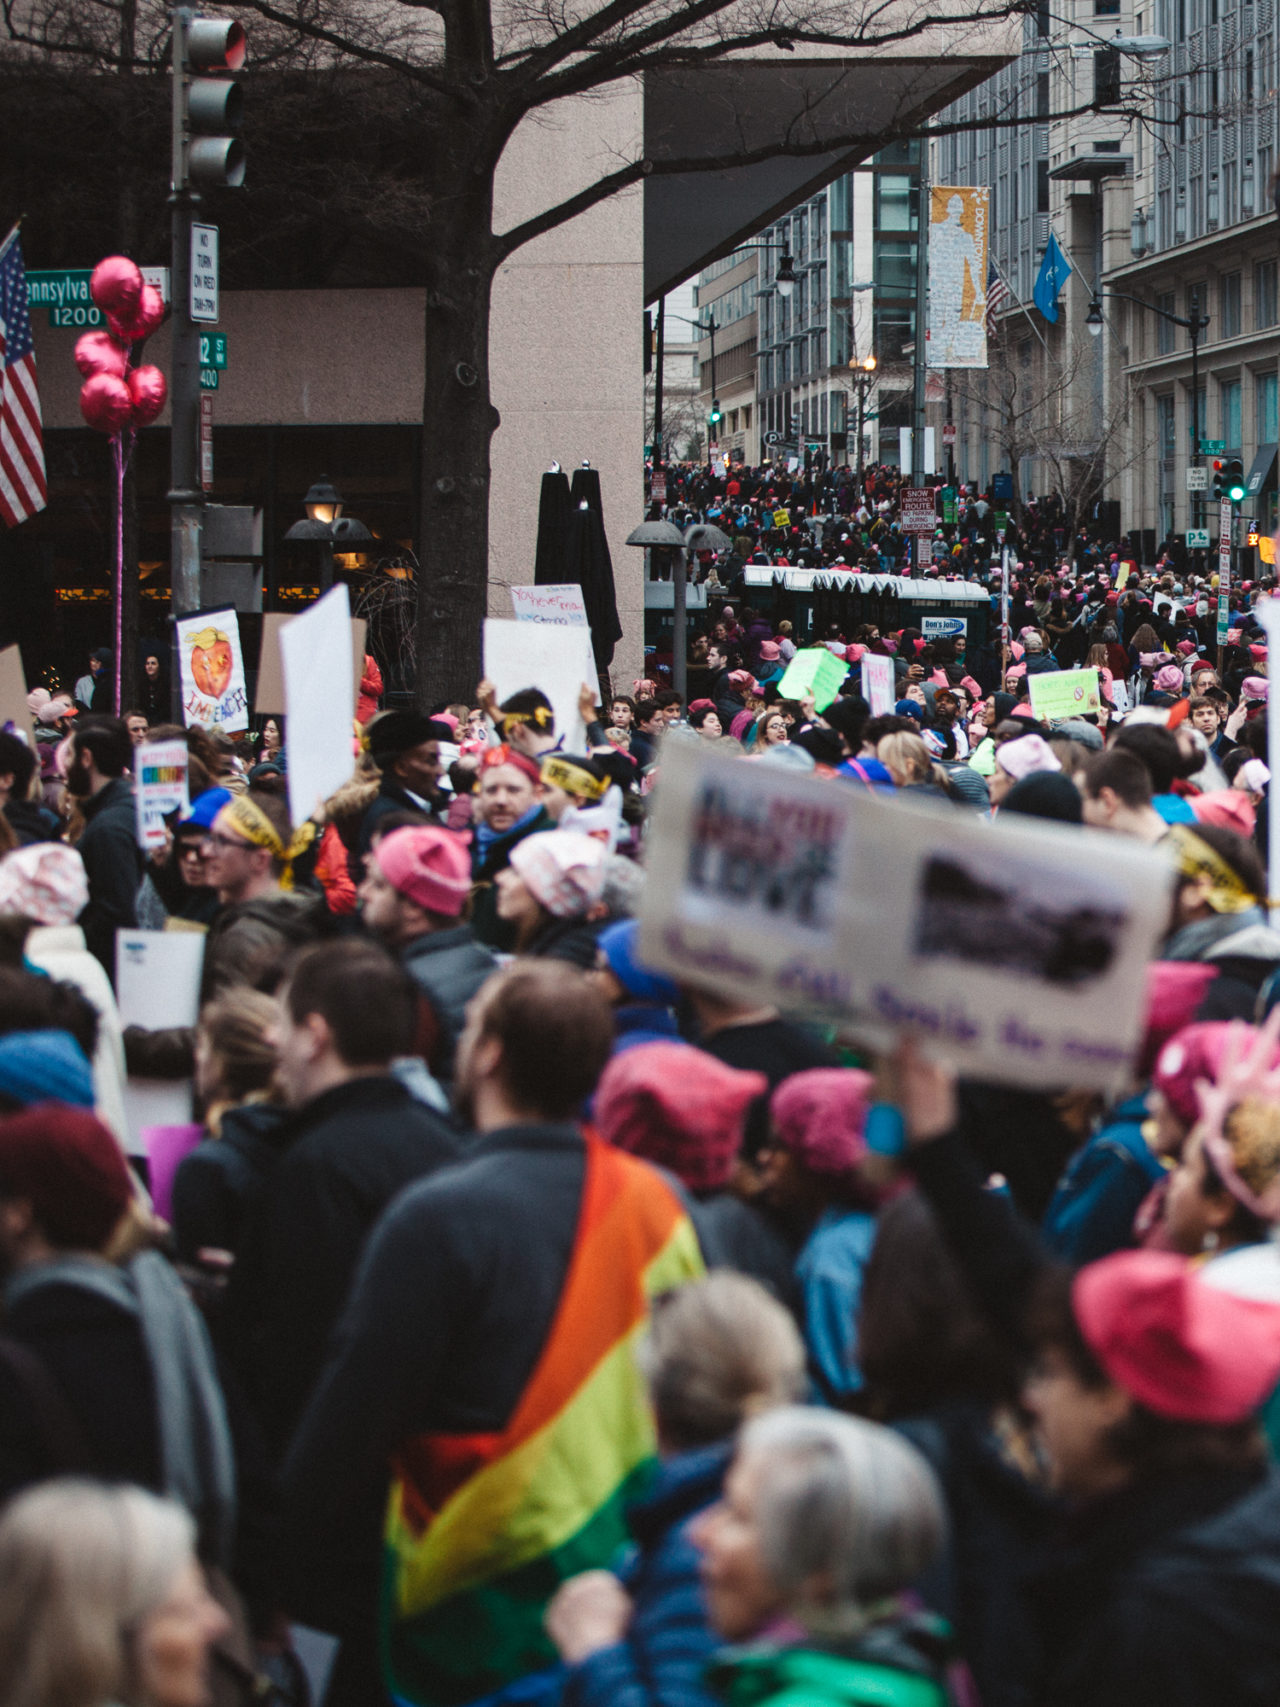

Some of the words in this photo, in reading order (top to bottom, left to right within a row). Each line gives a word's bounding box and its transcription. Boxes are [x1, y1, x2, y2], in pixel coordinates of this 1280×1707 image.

[200, 234, 209, 248] NO
[197, 254, 212, 269] TURN
[194, 275, 203, 288] ON
[204, 276, 216, 290] RED
[26, 275, 89, 306] ennsylva
[54, 307, 100, 325] 1200
[906, 490, 929, 498] SNOW
[904, 502, 931, 510] ROUTE
[925, 620, 943, 628] Don's
[943, 620, 963, 629] Johns
